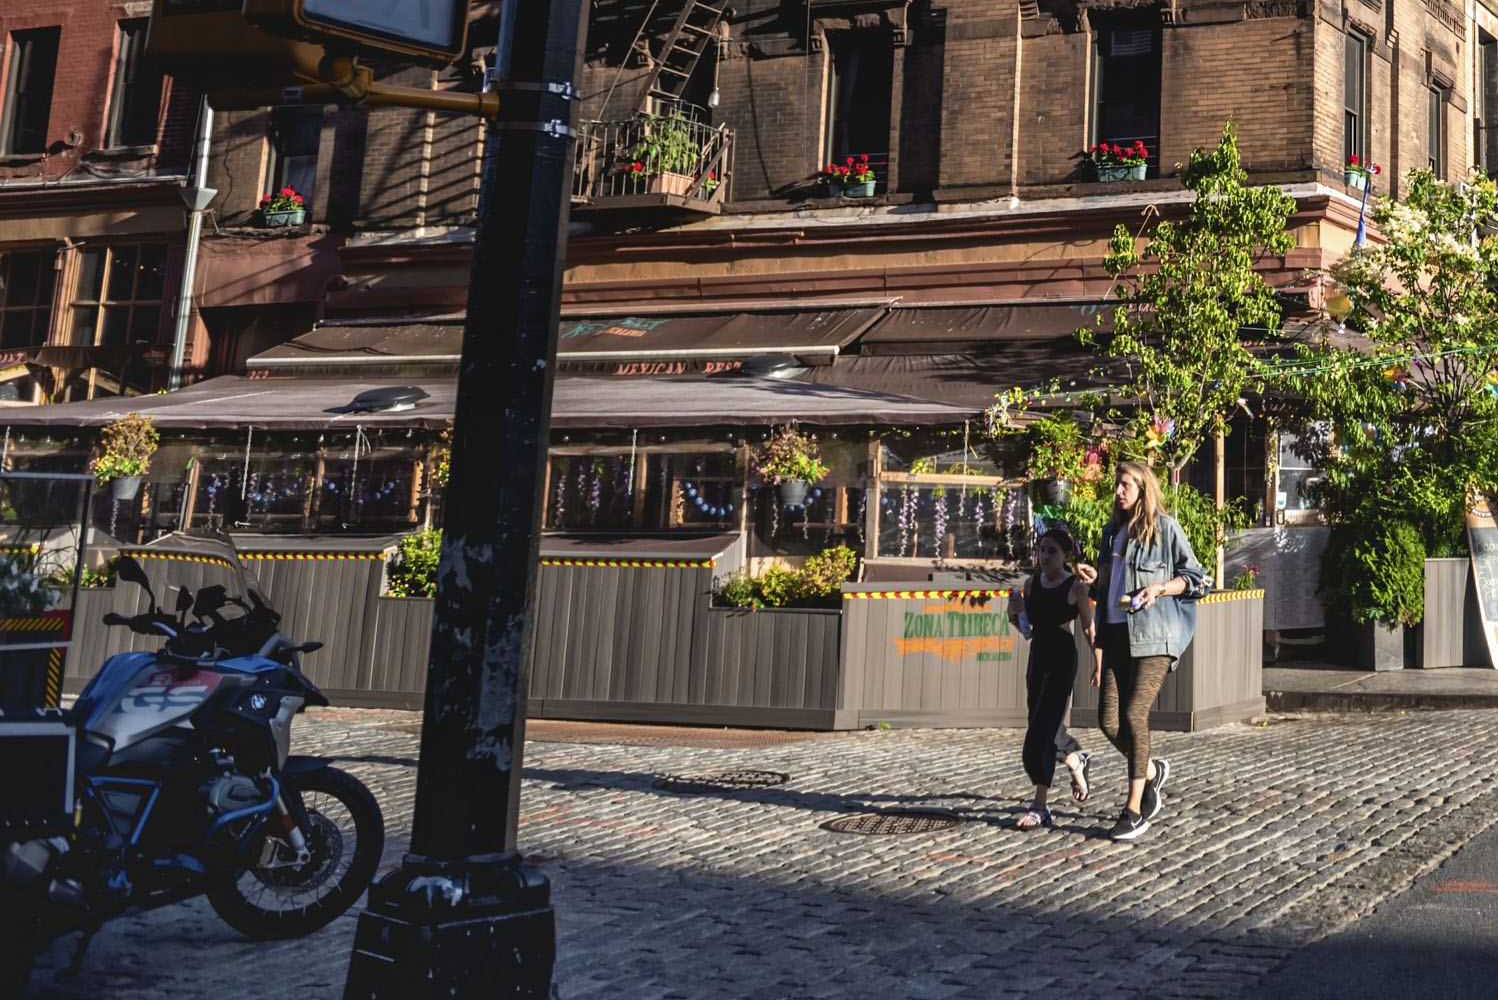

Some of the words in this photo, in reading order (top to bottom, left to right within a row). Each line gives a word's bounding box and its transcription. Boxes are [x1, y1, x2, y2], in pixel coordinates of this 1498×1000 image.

[613, 361, 687, 376] MEXICAN
[904, 611, 944, 638] ZONA
[947, 610, 1010, 638] TRIBECA
